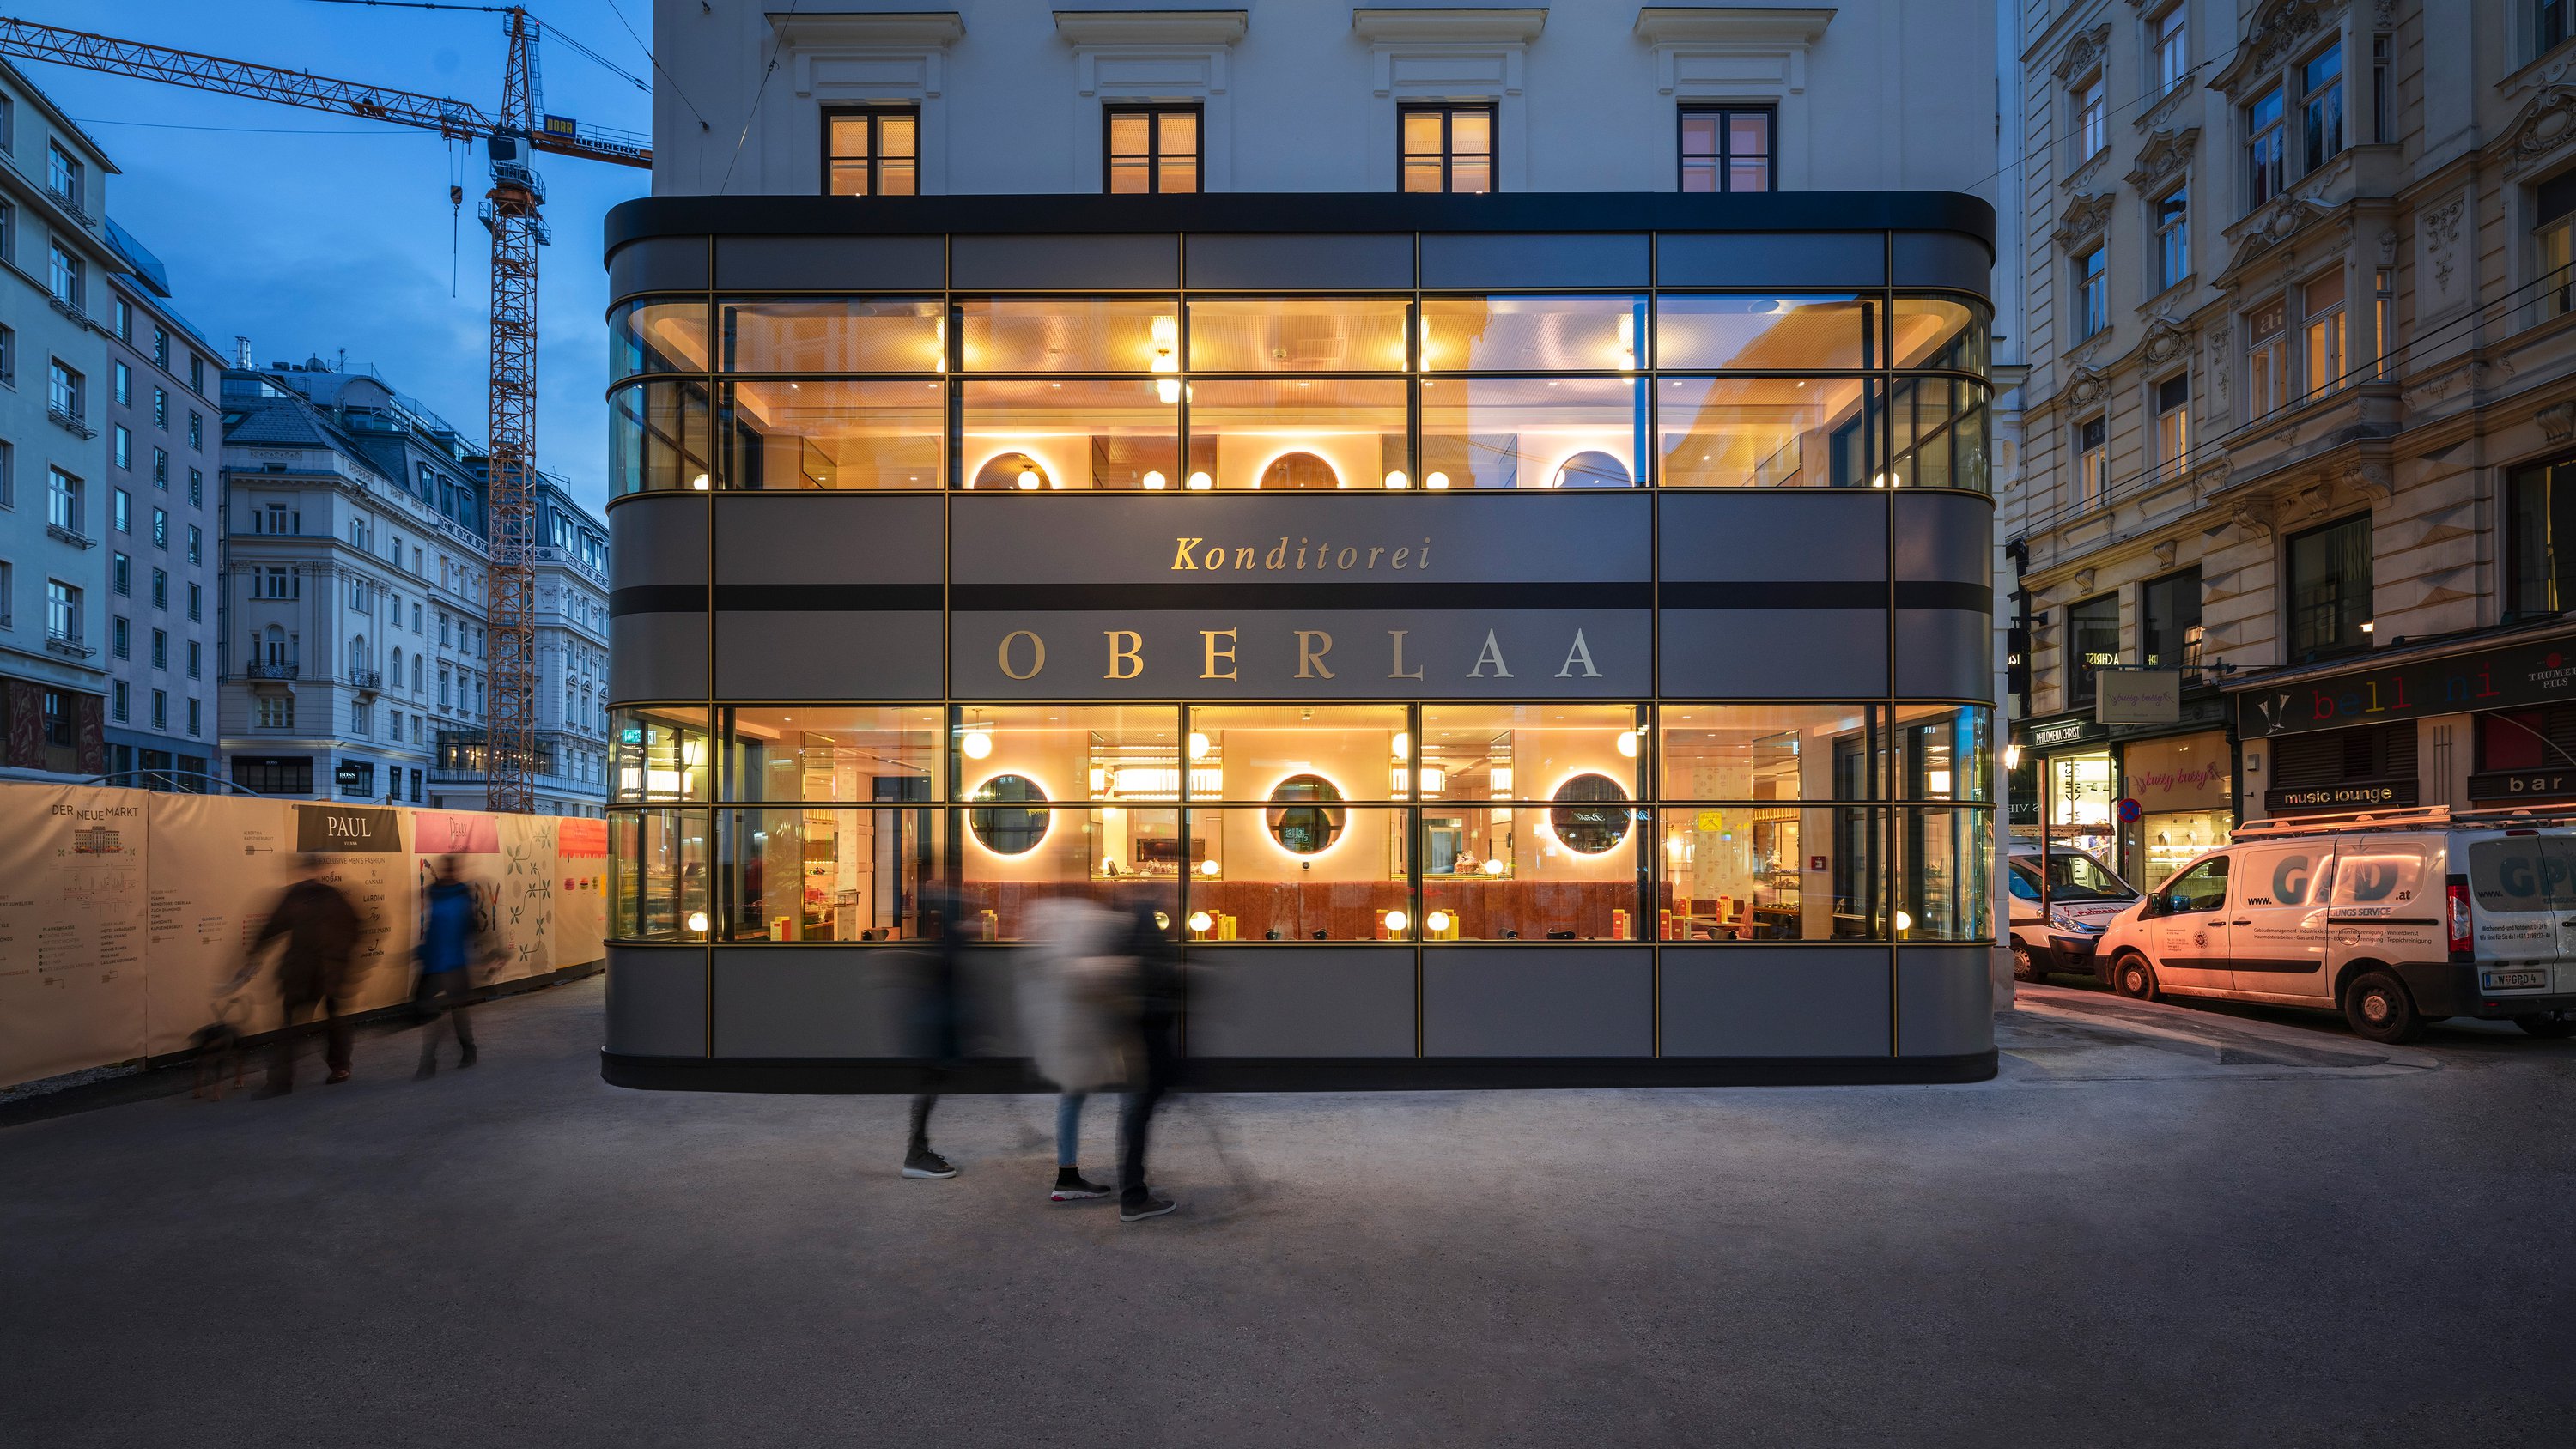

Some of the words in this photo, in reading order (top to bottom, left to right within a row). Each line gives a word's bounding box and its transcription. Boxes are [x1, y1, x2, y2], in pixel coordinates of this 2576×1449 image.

[576, 138, 639, 155] LIEBHERR
[1171, 537, 1431, 571] Konditorei
[998, 627, 1603, 683] OBERLAA
[2312, 662, 2500, 720] bellni
[2542, 678, 2568, 688] PILS
[2036, 730, 2062, 744] PHILOMENA
[2063, 725, 2080, 739] CHRIST
[2509, 776, 2563, 792] bar
[2284, 791, 2330, 804] music
[2335, 787, 2392, 803] lounge
[52, 804, 74, 815] DER
[76, 810, 105, 821] NEUE
[106, 807, 138, 817] MARKT
[327, 816, 372, 838] PAUL
[2500, 858, 2576, 898] GP
[362, 894, 386, 903] LARDINI
[2248, 897, 2272, 906] www.
[2396, 890, 2410, 900] .at
[2358, 907, 2391, 917] SERVICE
[2387, 937, 2433, 945] Teppichreinigung
[2498, 975, 2505, 985] W
[2512, 974, 2529, 985] GPD
[2530, 974, 2536, 984] 4
